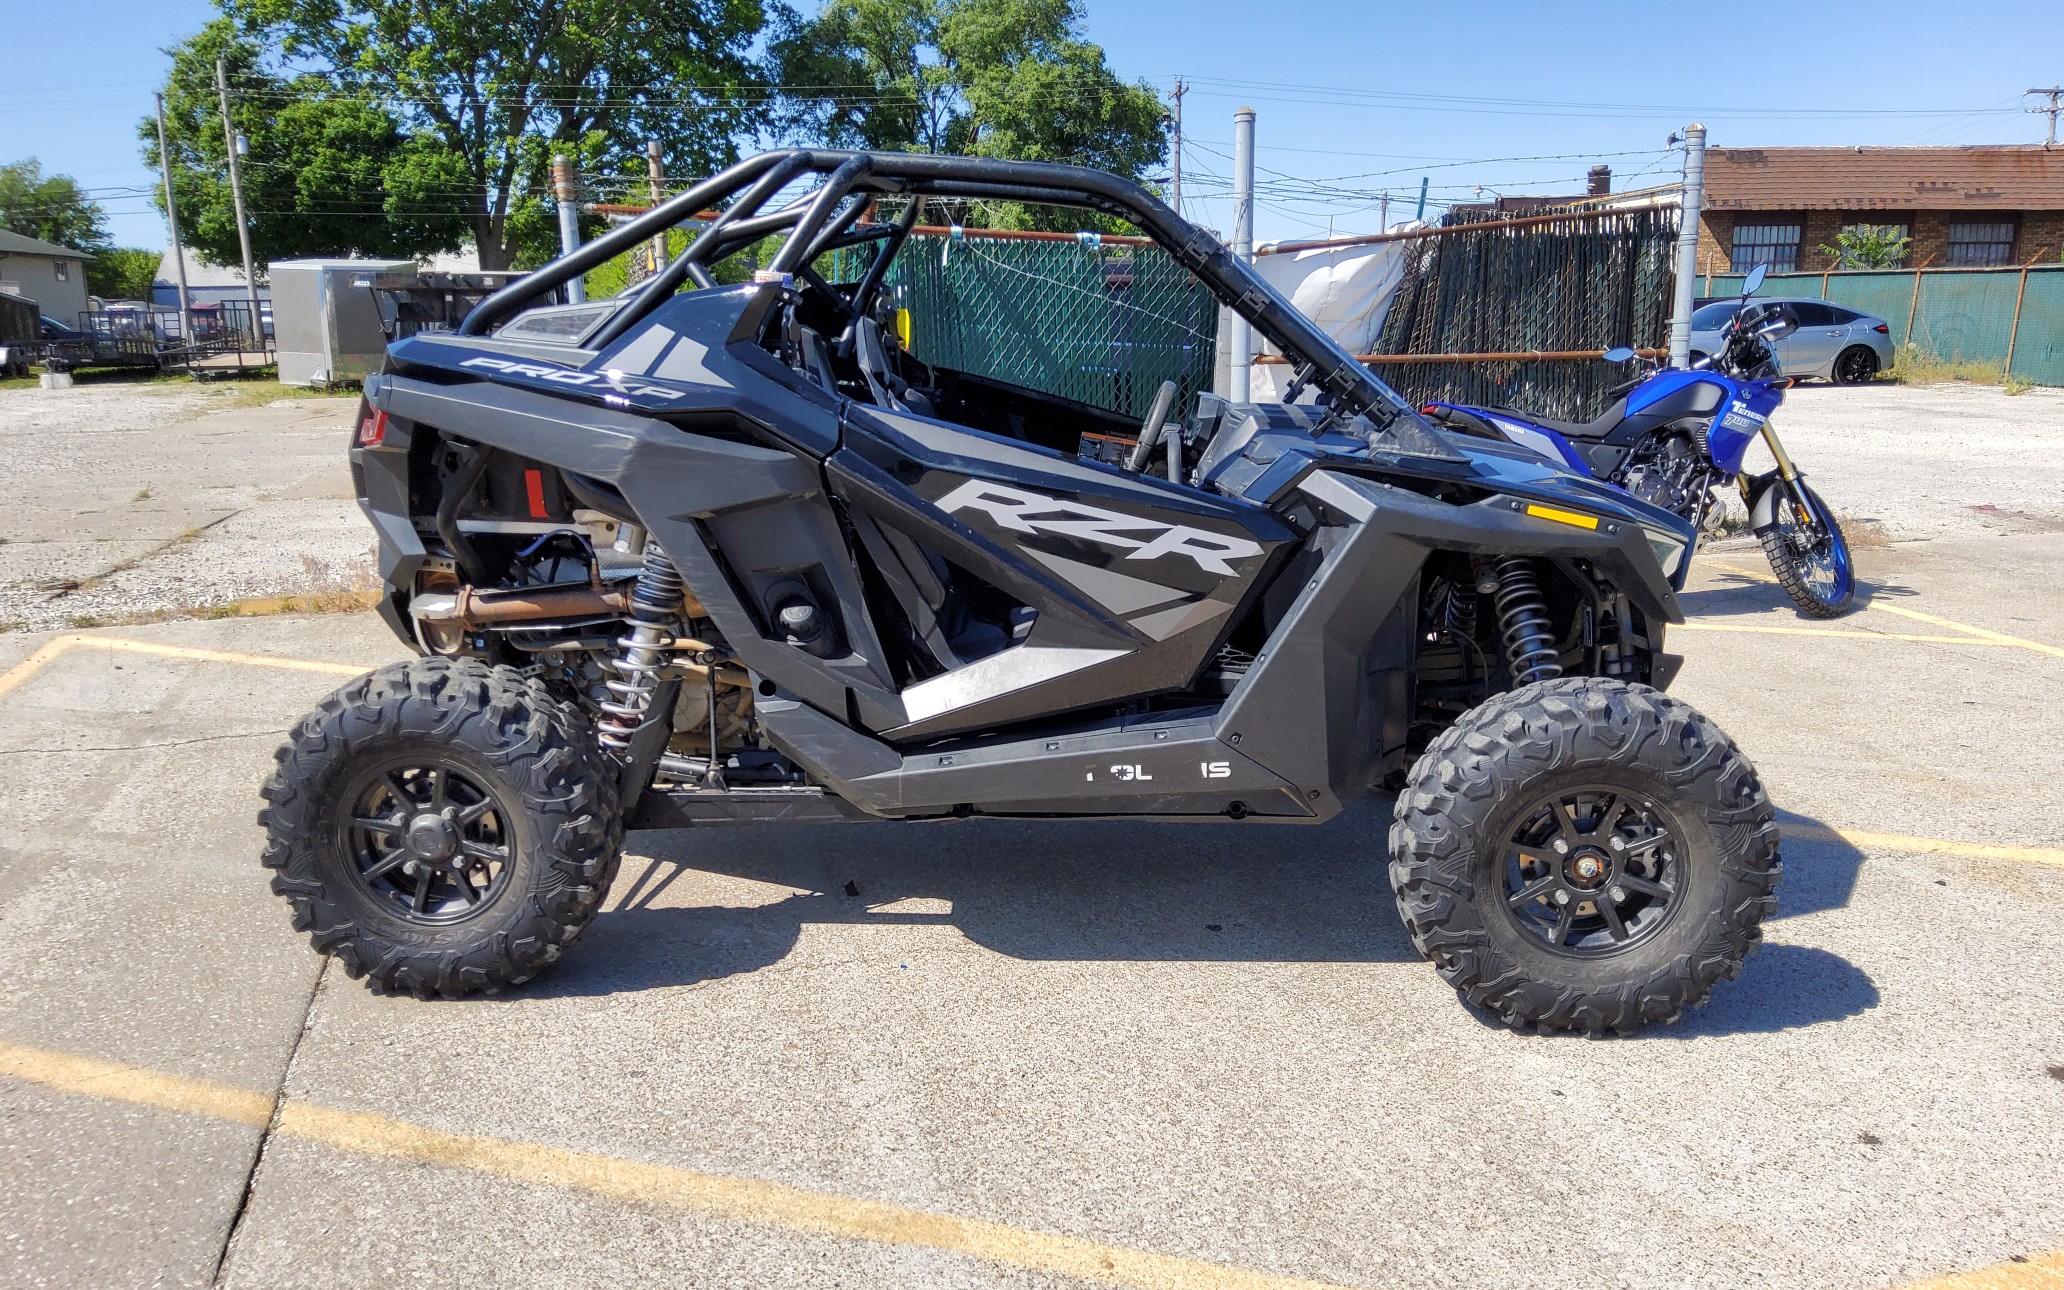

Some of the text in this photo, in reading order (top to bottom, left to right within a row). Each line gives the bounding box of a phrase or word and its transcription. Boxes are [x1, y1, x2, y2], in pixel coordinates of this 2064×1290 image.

[459, 357, 687, 400] PRO XP
[1504, 423, 1525, 435] YAMAHA
[1723, 413, 1750, 428] 700
[934, 478, 1265, 578] RZR
